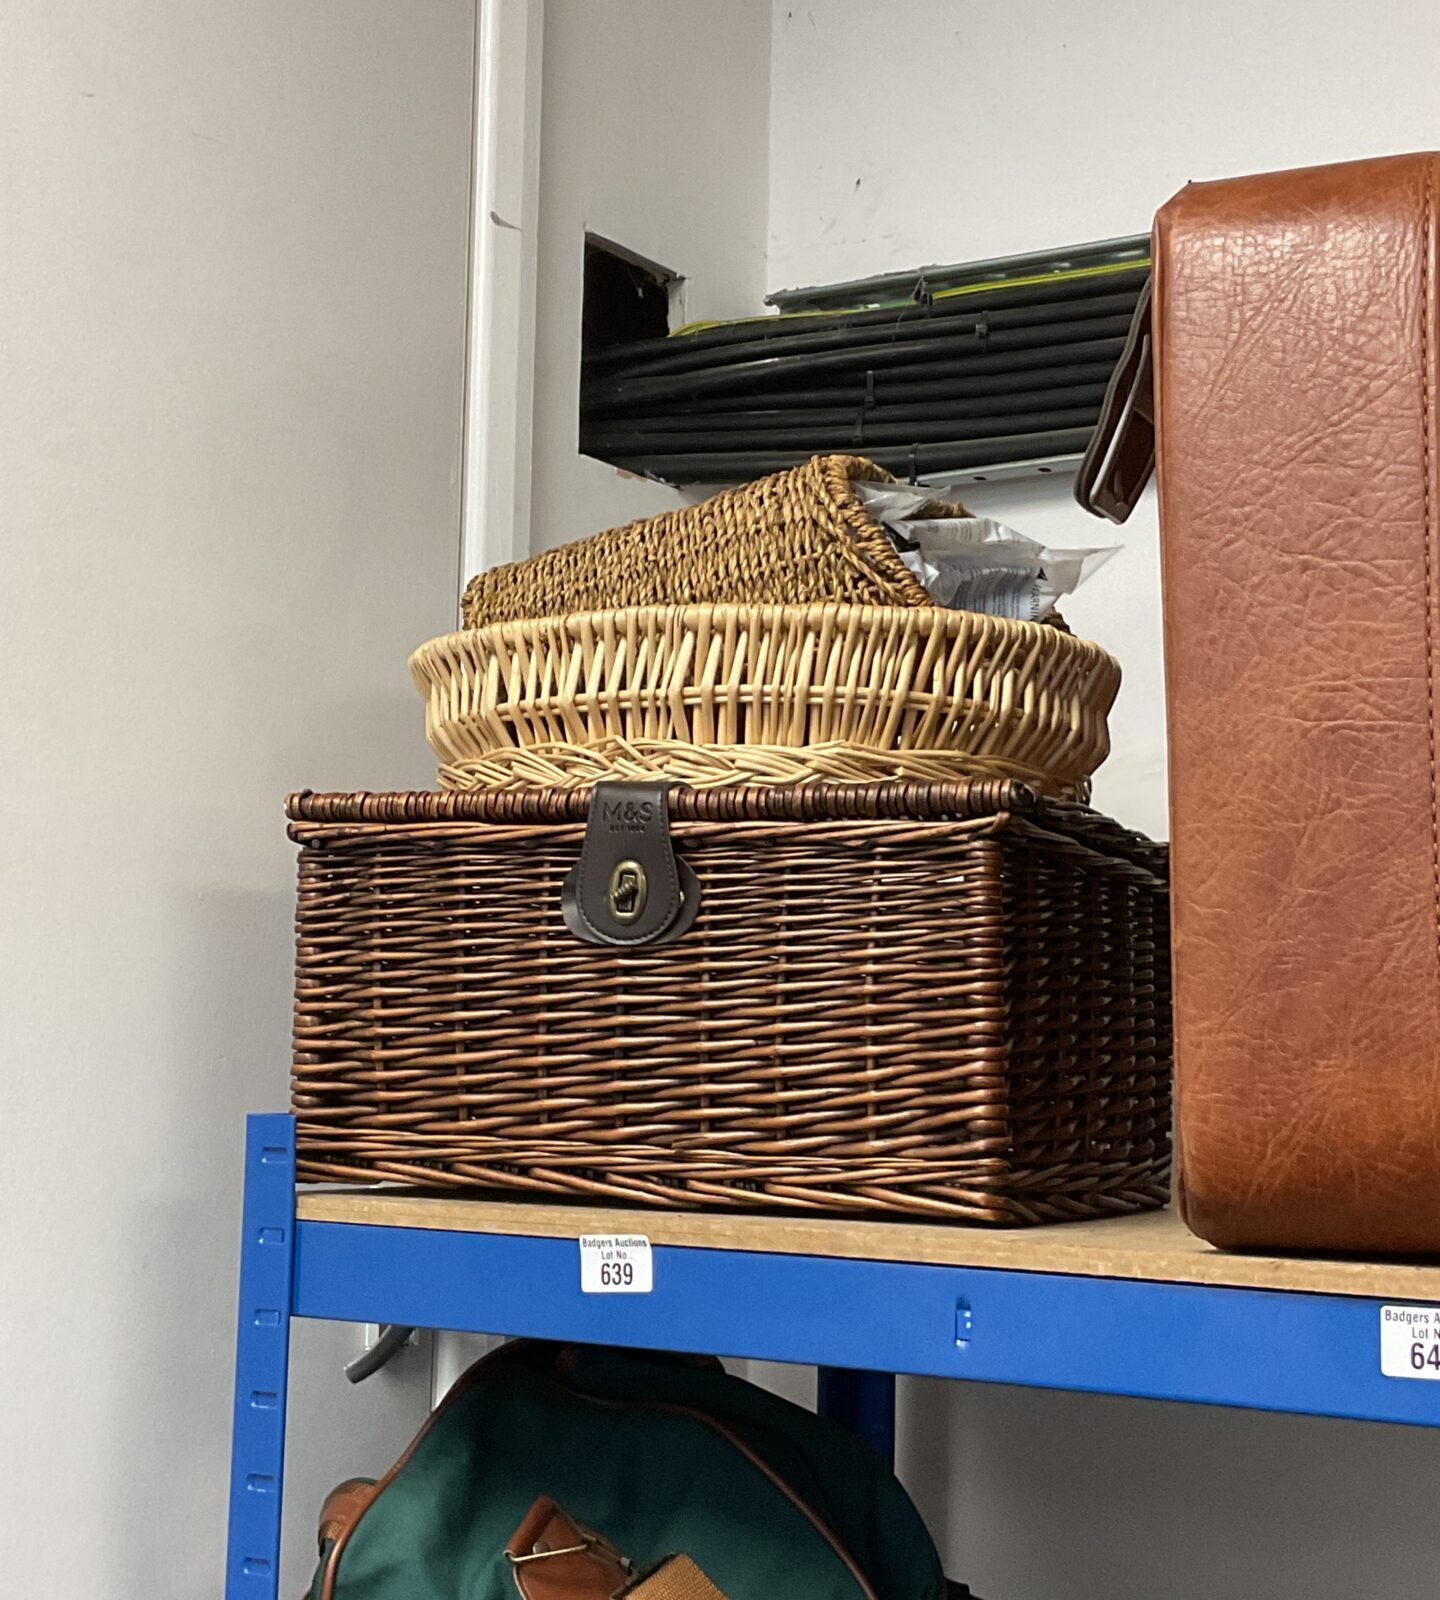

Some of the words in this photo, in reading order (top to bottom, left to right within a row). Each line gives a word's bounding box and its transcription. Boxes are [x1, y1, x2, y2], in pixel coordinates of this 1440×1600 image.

[603, 801, 653, 822] M&S
[582, 1238, 613, 1249] Badgers
[615, 1238, 647, 1247] Auctions
[601, 1250, 613, 1260] Lot
[601, 1262, 633, 1285] 639
[1385, 1309, 1429, 1325] Badgers
[1412, 1327, 1428, 1339] Lot
[1411, 1342, 1440, 1371] 64
